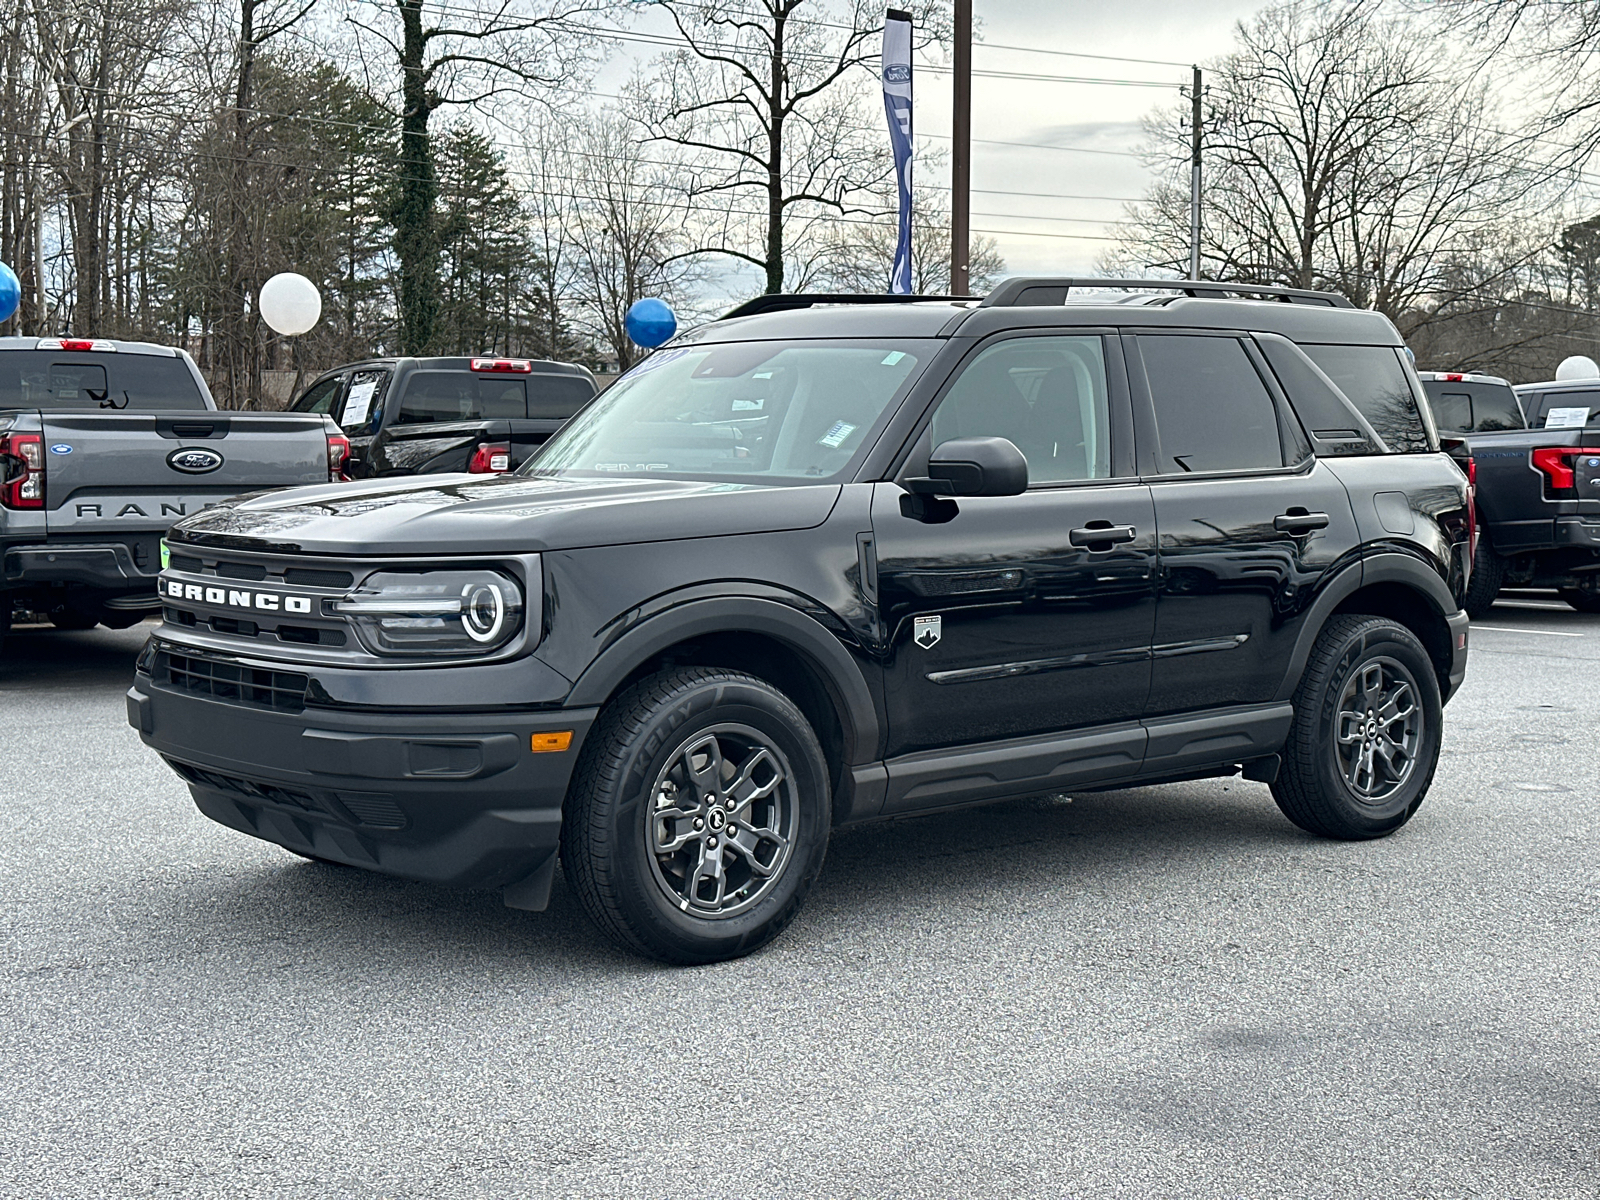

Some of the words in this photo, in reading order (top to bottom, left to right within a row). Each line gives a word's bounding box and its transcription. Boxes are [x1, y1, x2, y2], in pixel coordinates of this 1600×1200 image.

[184, 454, 211, 467] Ford
[75, 503, 218, 518] RAN
[168, 581, 311, 613] BRONCO
[1322, 653, 1350, 719] KELLY
[634, 702, 693, 777] KELLY
